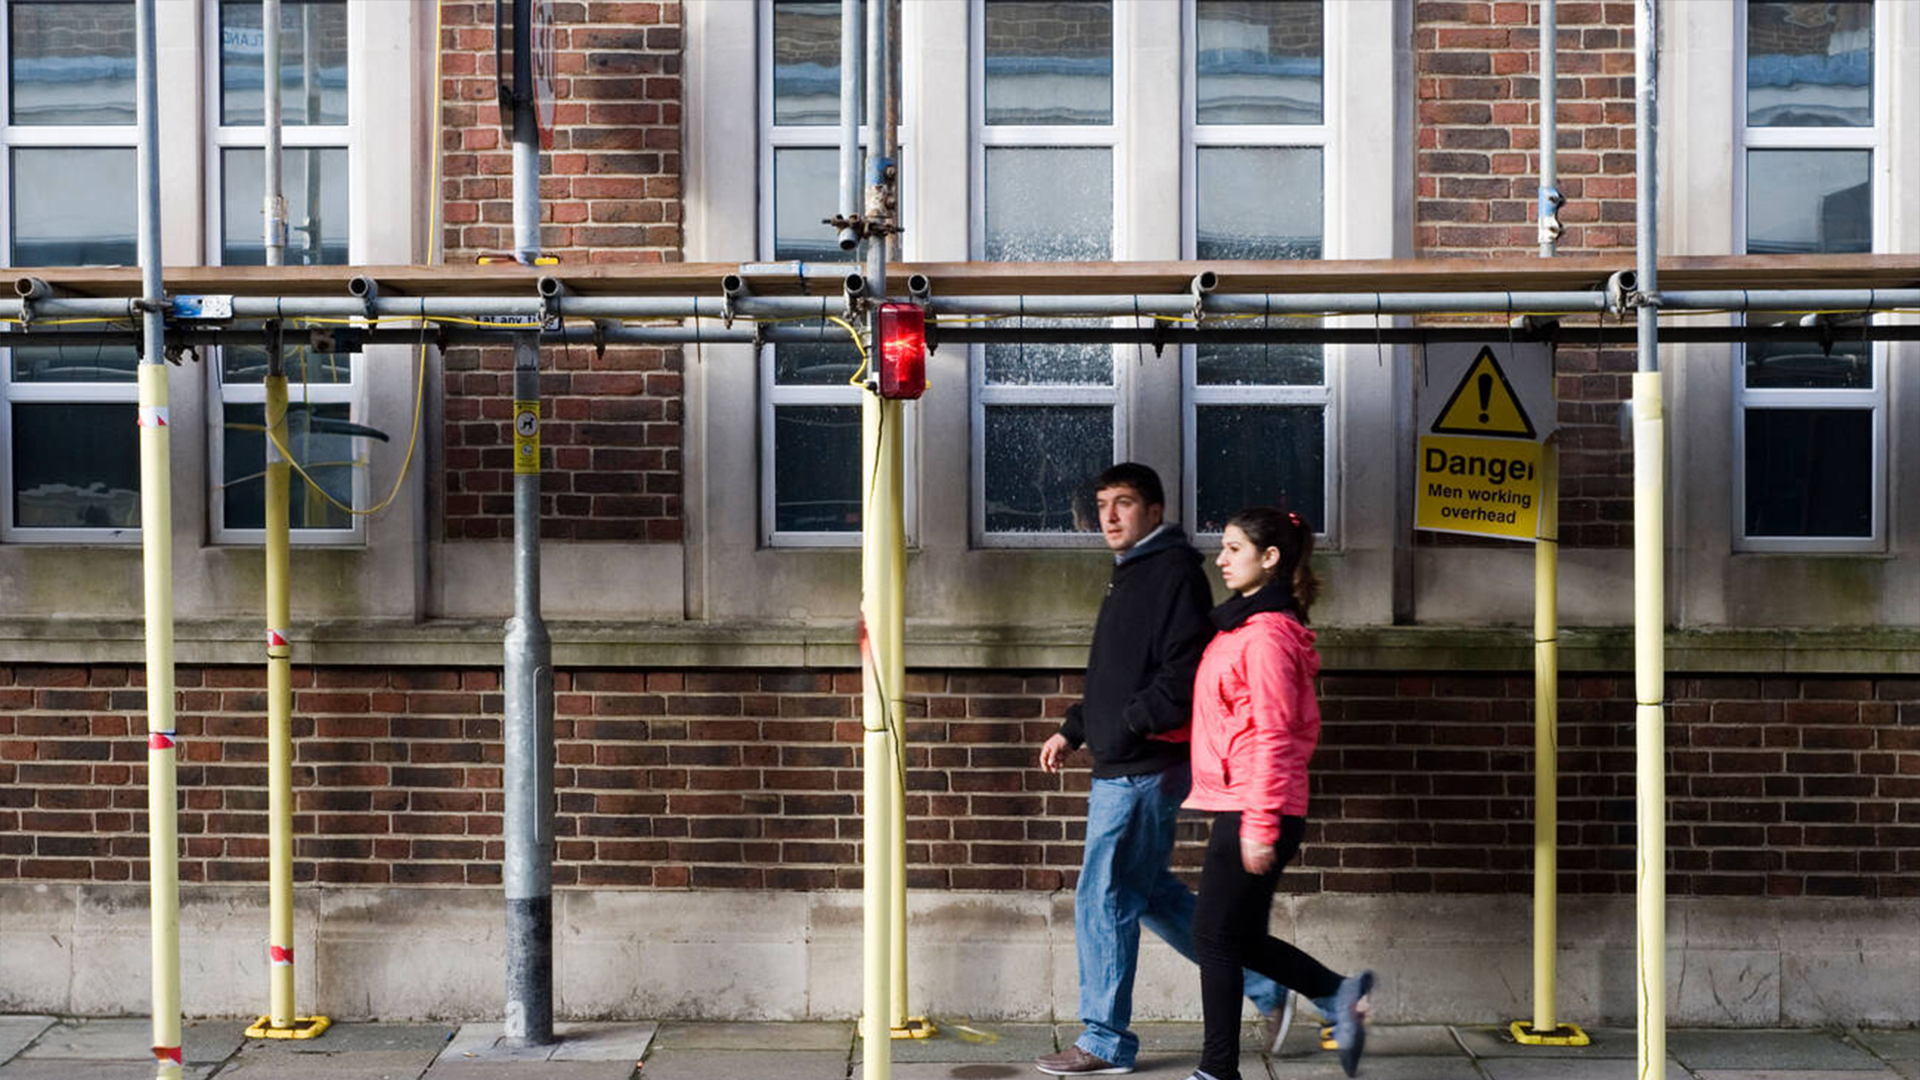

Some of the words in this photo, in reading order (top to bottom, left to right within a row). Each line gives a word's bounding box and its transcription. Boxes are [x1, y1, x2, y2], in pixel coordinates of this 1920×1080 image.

[483, 314, 495, 323] at
[500, 316, 522, 324] any
[1428, 483, 1463, 499] Men
[1468, 488, 1532, 509] working
[1441, 506, 1516, 524] overhead
